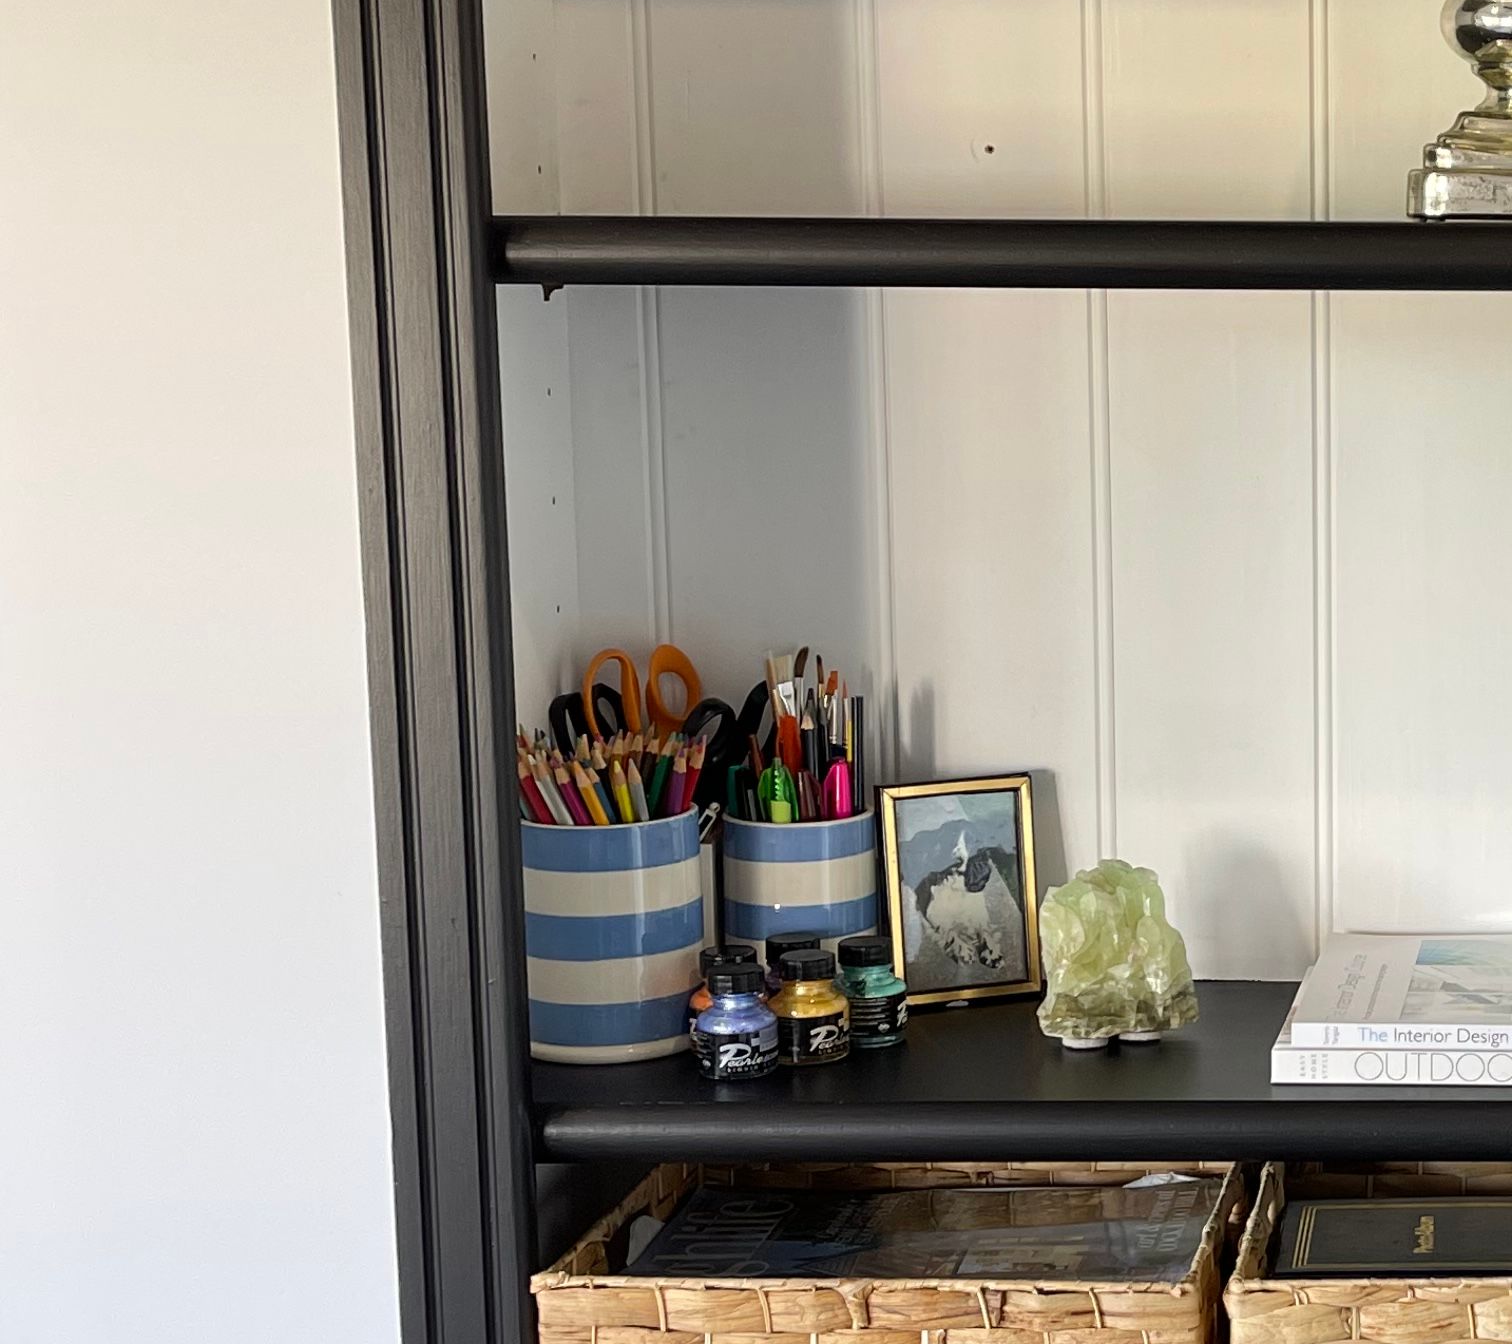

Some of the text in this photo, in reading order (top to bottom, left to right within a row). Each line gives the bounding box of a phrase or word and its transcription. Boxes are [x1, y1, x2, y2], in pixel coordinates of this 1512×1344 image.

[1358, 1027, 1388, 1043] The
[1394, 1027, 1452, 1043] Interior
[1457, 1028, 1508, 1047] Design
